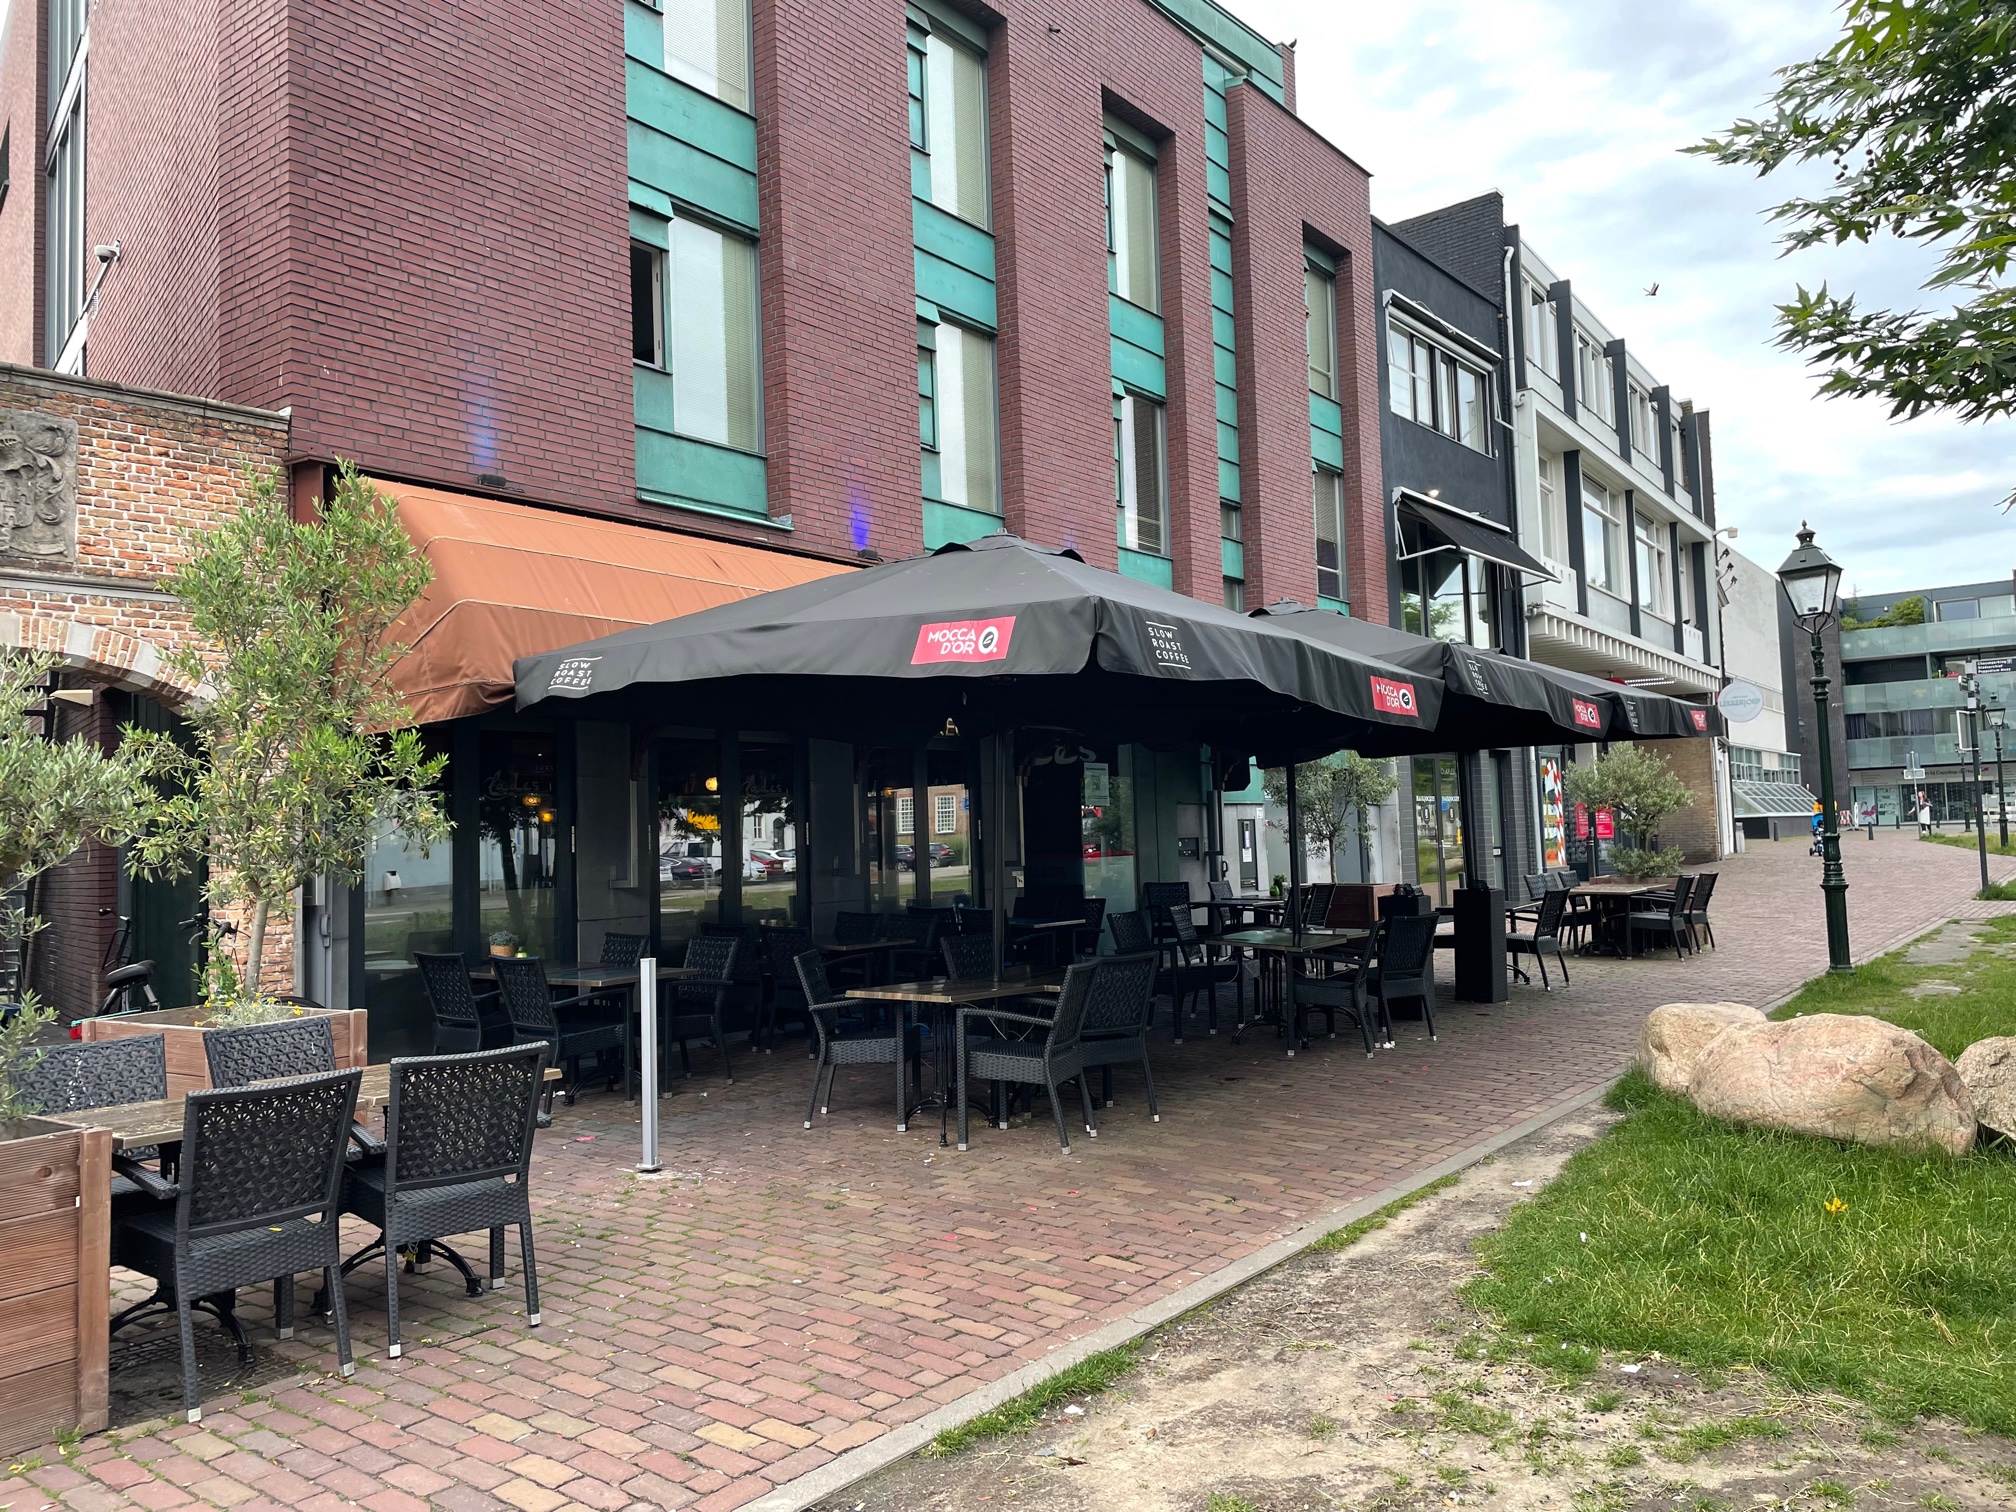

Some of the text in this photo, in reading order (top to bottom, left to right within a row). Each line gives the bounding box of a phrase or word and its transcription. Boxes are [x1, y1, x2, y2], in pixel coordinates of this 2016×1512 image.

[927, 628, 976, 643] MOCCA
[1148, 627, 1173, 639] SLOW
[940, 642, 975, 655] D'OR
[1151, 638, 1182, 651] ROAST
[1155, 650, 1189, 664] COFFEE
[558, 662, 591, 670] SLOW
[550, 677, 592, 685] COFFEE
[1376, 684, 1399, 698] MOCCA
